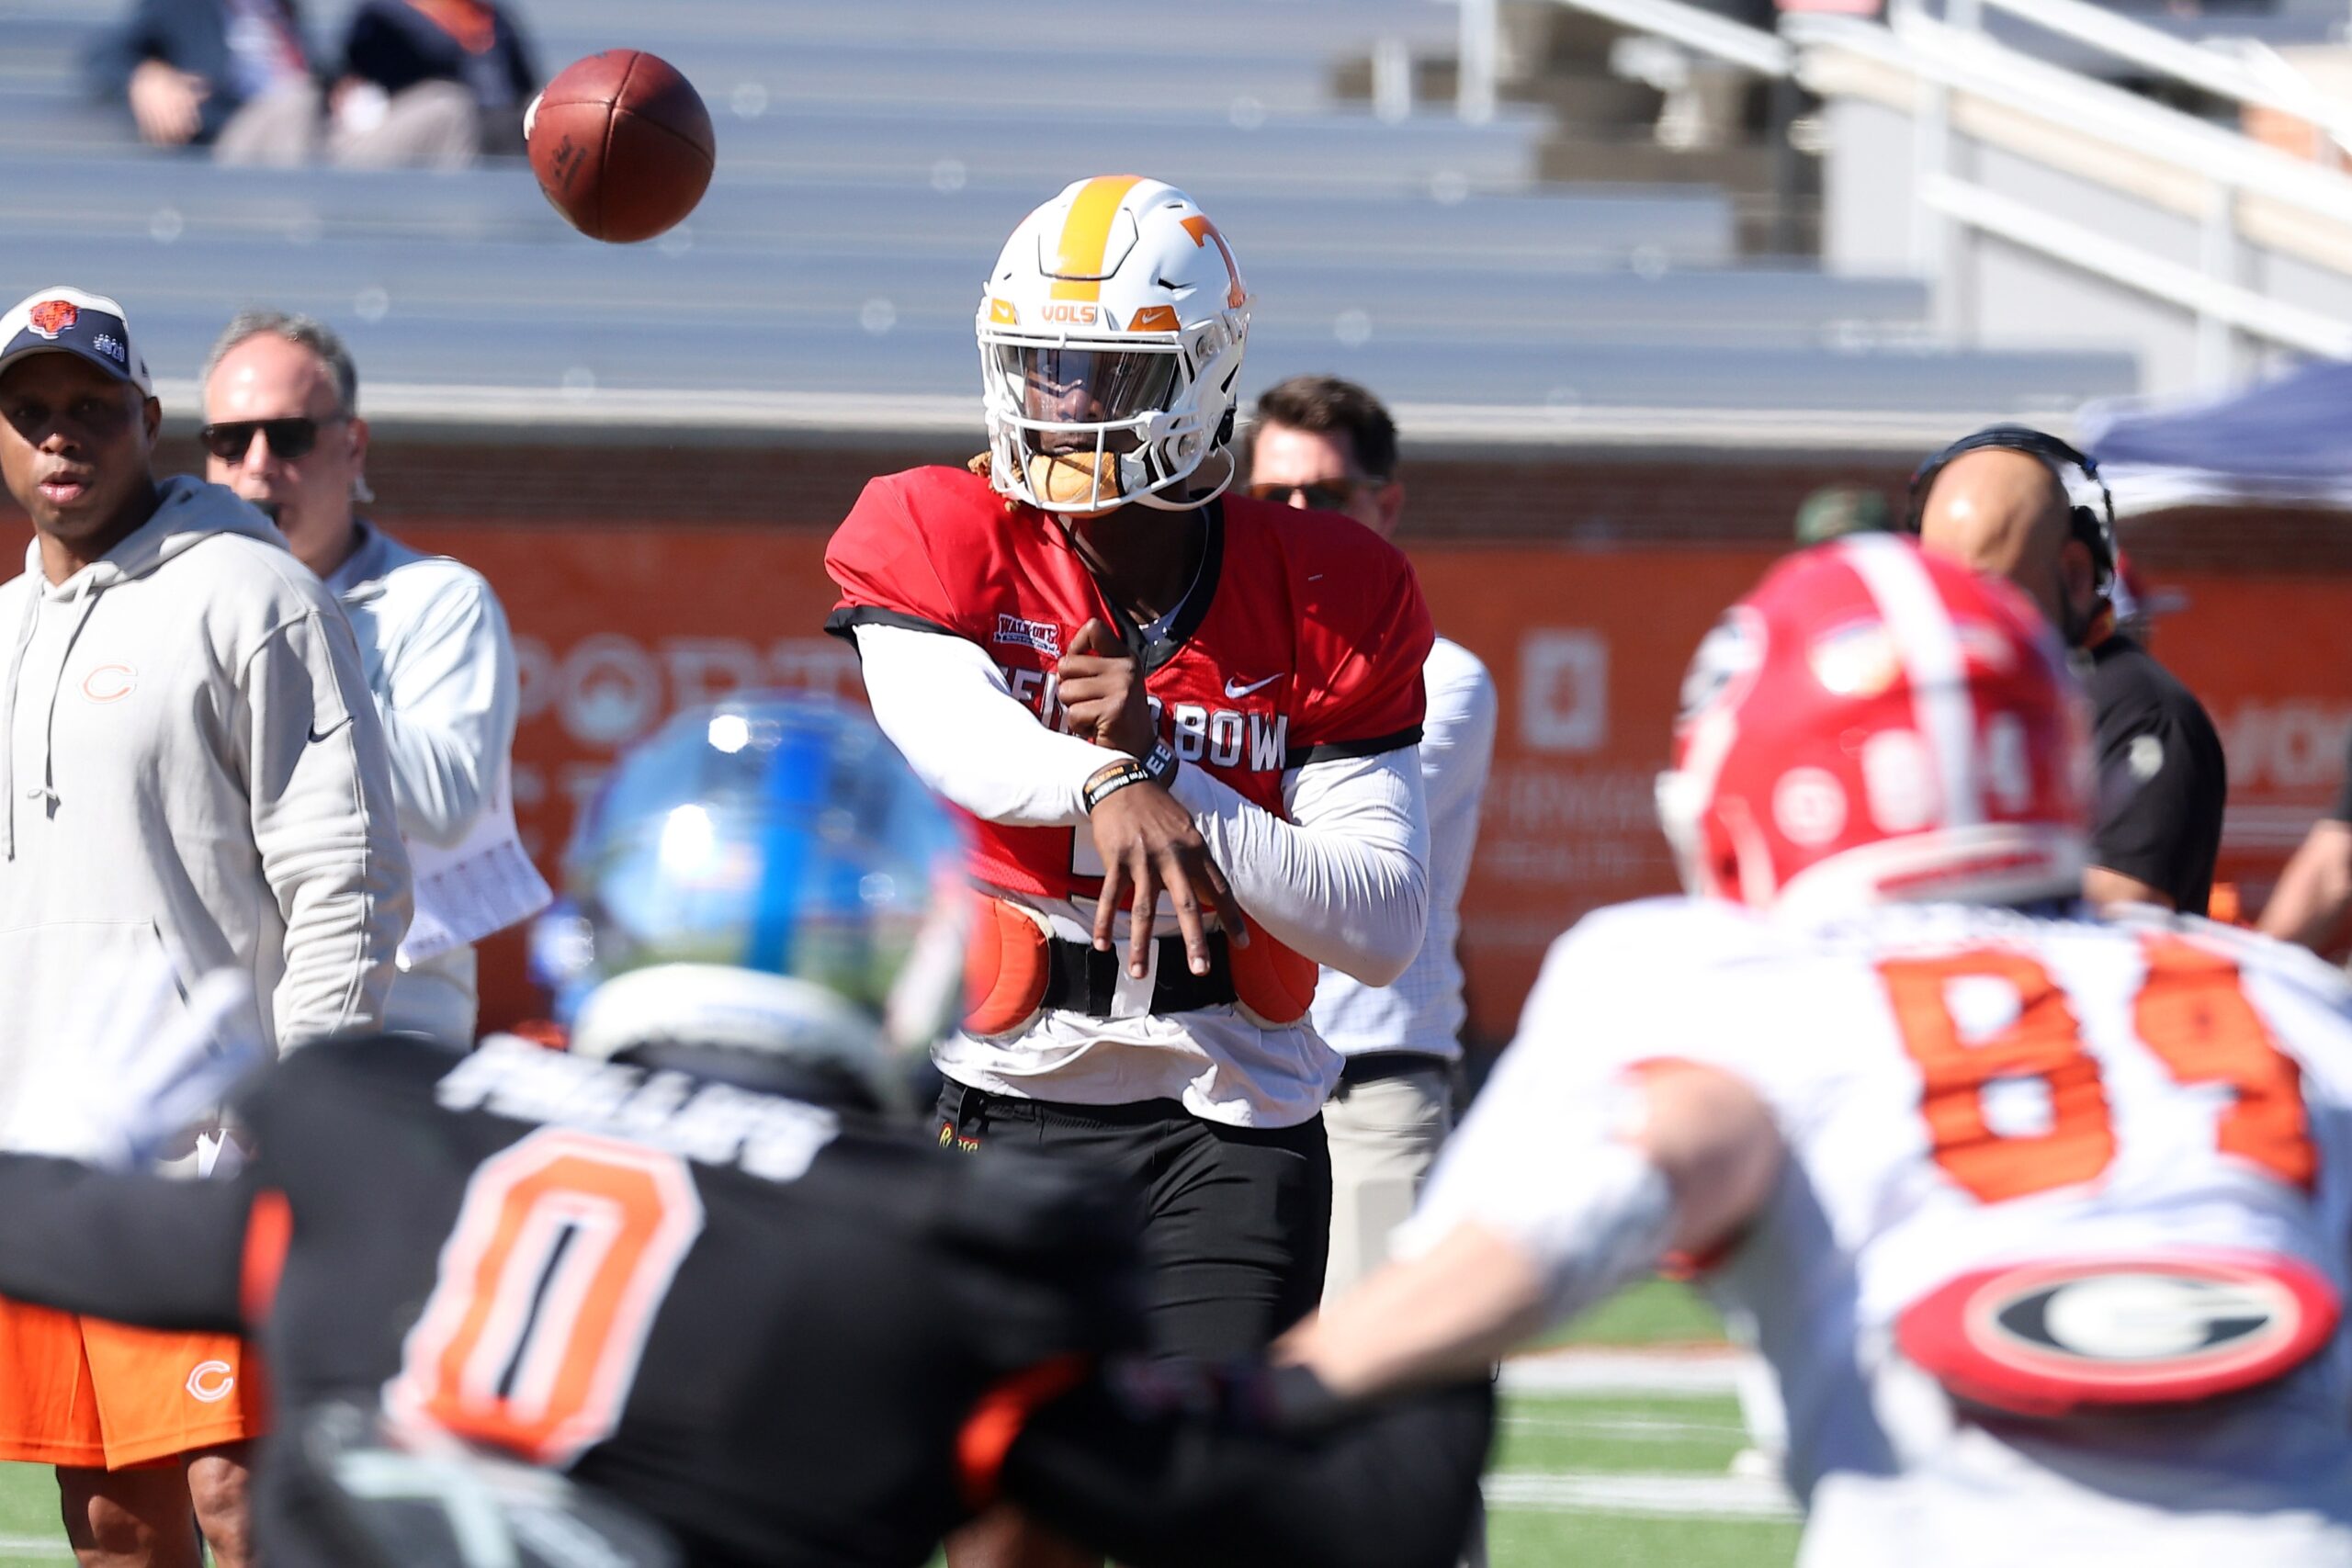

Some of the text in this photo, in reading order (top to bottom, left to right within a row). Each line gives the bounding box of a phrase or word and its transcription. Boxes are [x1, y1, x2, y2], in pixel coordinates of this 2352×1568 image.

[1041, 305, 1095, 322] VOLS
[76, 660, 138, 705] C
[1174, 703, 1288, 772] BOW
[380, 1125, 706, 1470] 0
[186, 1359, 234, 1402] C
